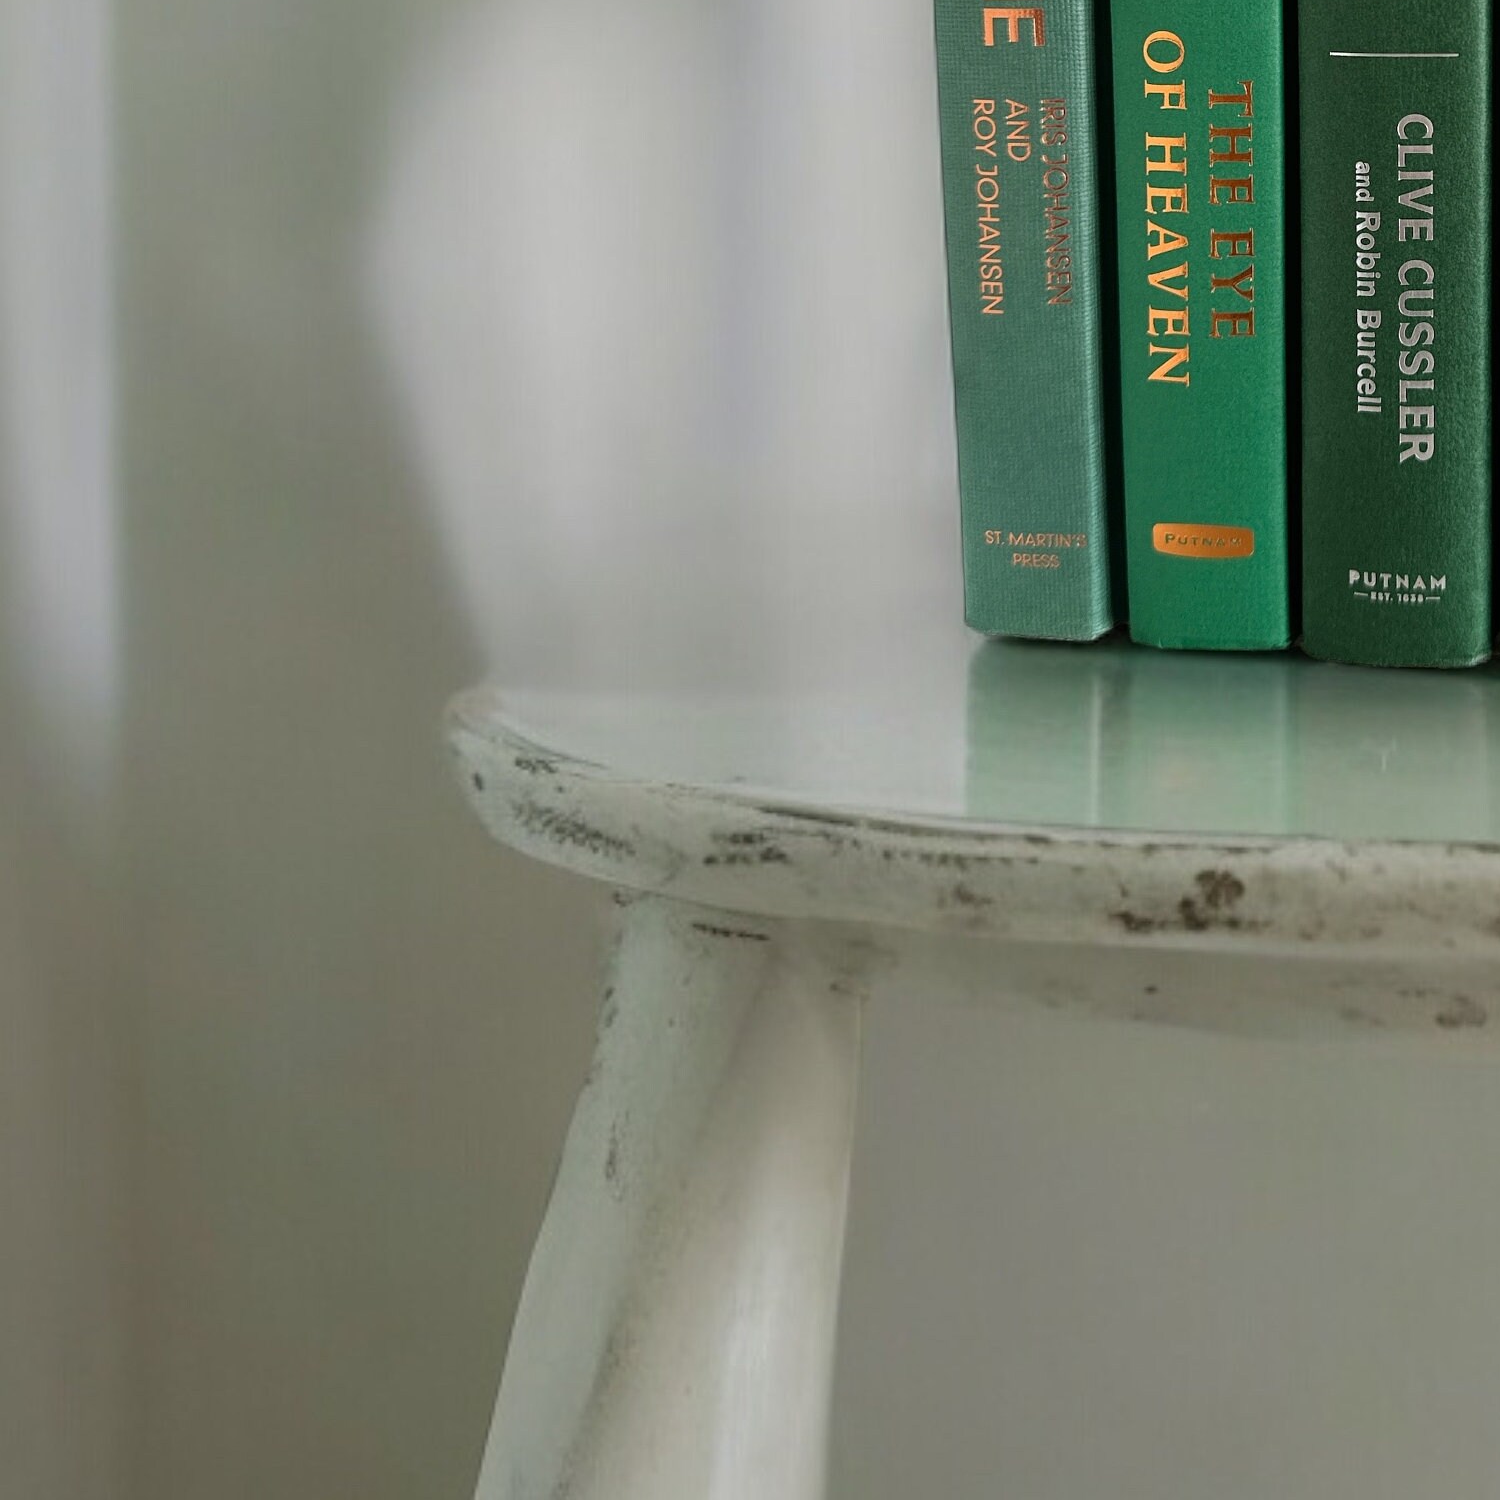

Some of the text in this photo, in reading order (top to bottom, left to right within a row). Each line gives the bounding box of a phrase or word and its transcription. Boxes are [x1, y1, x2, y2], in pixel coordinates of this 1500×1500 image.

[973, 99, 1004, 314] ROY JOHANSEN
[1005, 99, 1032, 161] AND
[1039, 99, 1073, 305] IRIS JOHANSEN
[1143, 30, 1191, 388] OF HEAVEN
[1208, 80, 1256, 338] THE EYE
[1355, 161, 1382, 413] and Robin Burcell
[1397, 113, 1435, 463] CLIVE CUSSLER
[985, 530, 1088, 549] ST. MARTIN'S
[1012, 553, 1060, 569] PRESS
[1164, 533, 1243, 547] PUTNAM
[1348, 569, 1447, 590] PUTNAM
